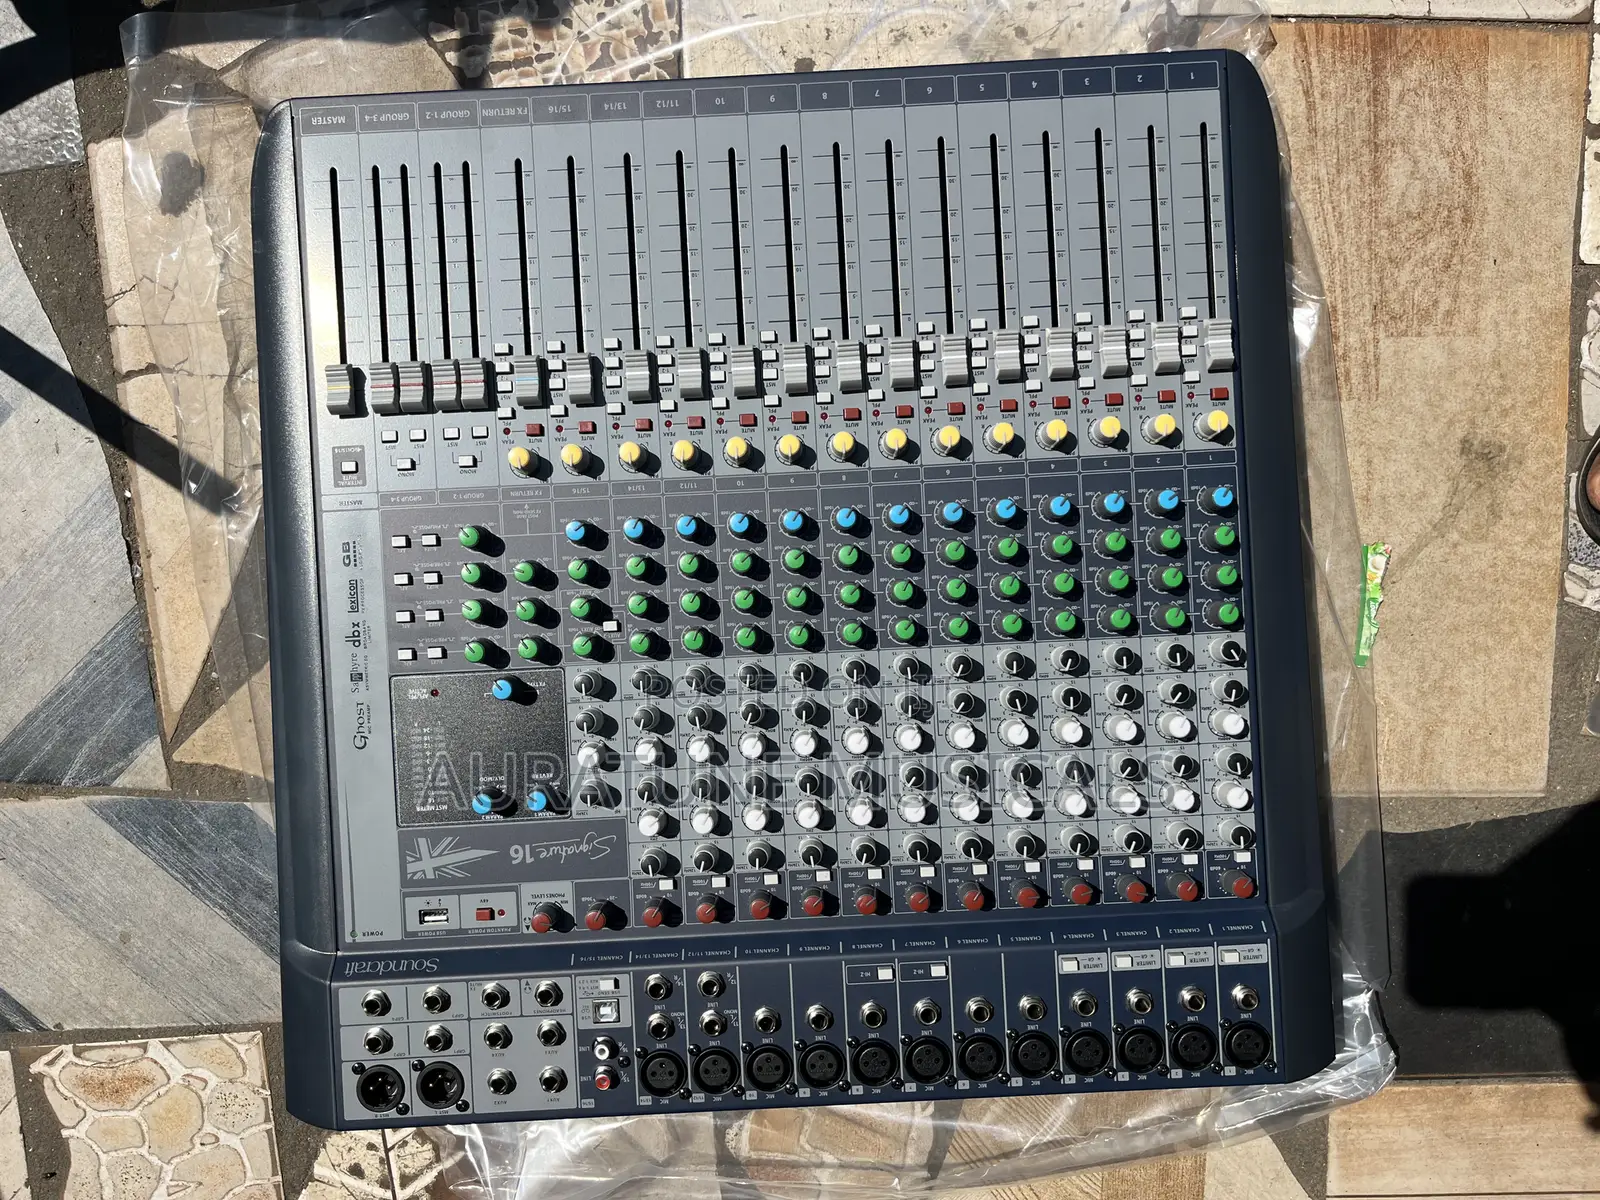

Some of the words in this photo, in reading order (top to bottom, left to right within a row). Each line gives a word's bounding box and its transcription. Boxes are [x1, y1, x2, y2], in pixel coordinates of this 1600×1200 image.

[604, 101, 627, 110] 13/14
[656, 98, 679, 108] 11/12
[715, 97, 725, 105] 10
[441, 109, 470, 118] GROUP
[482, 107, 516, 117] RETURN
[517, 106, 527, 115] FX
[548, 104, 572, 114] 15/16
[311, 115, 346, 125] MASTER
[364, 114, 380, 123] 3-4
[381, 111, 410, 120] GROUP
[425, 111, 440, 120] 1-2
[628, 484, 645, 492] 13/14
[342, 540, 351, 567] GB
[348, 579, 358, 613] lexicon
[345, 622, 361, 647] dbx
[534, 832, 617, 863] Signature
[509, 844, 534, 864] 16
[344, 957, 439, 976] Soundcraft
